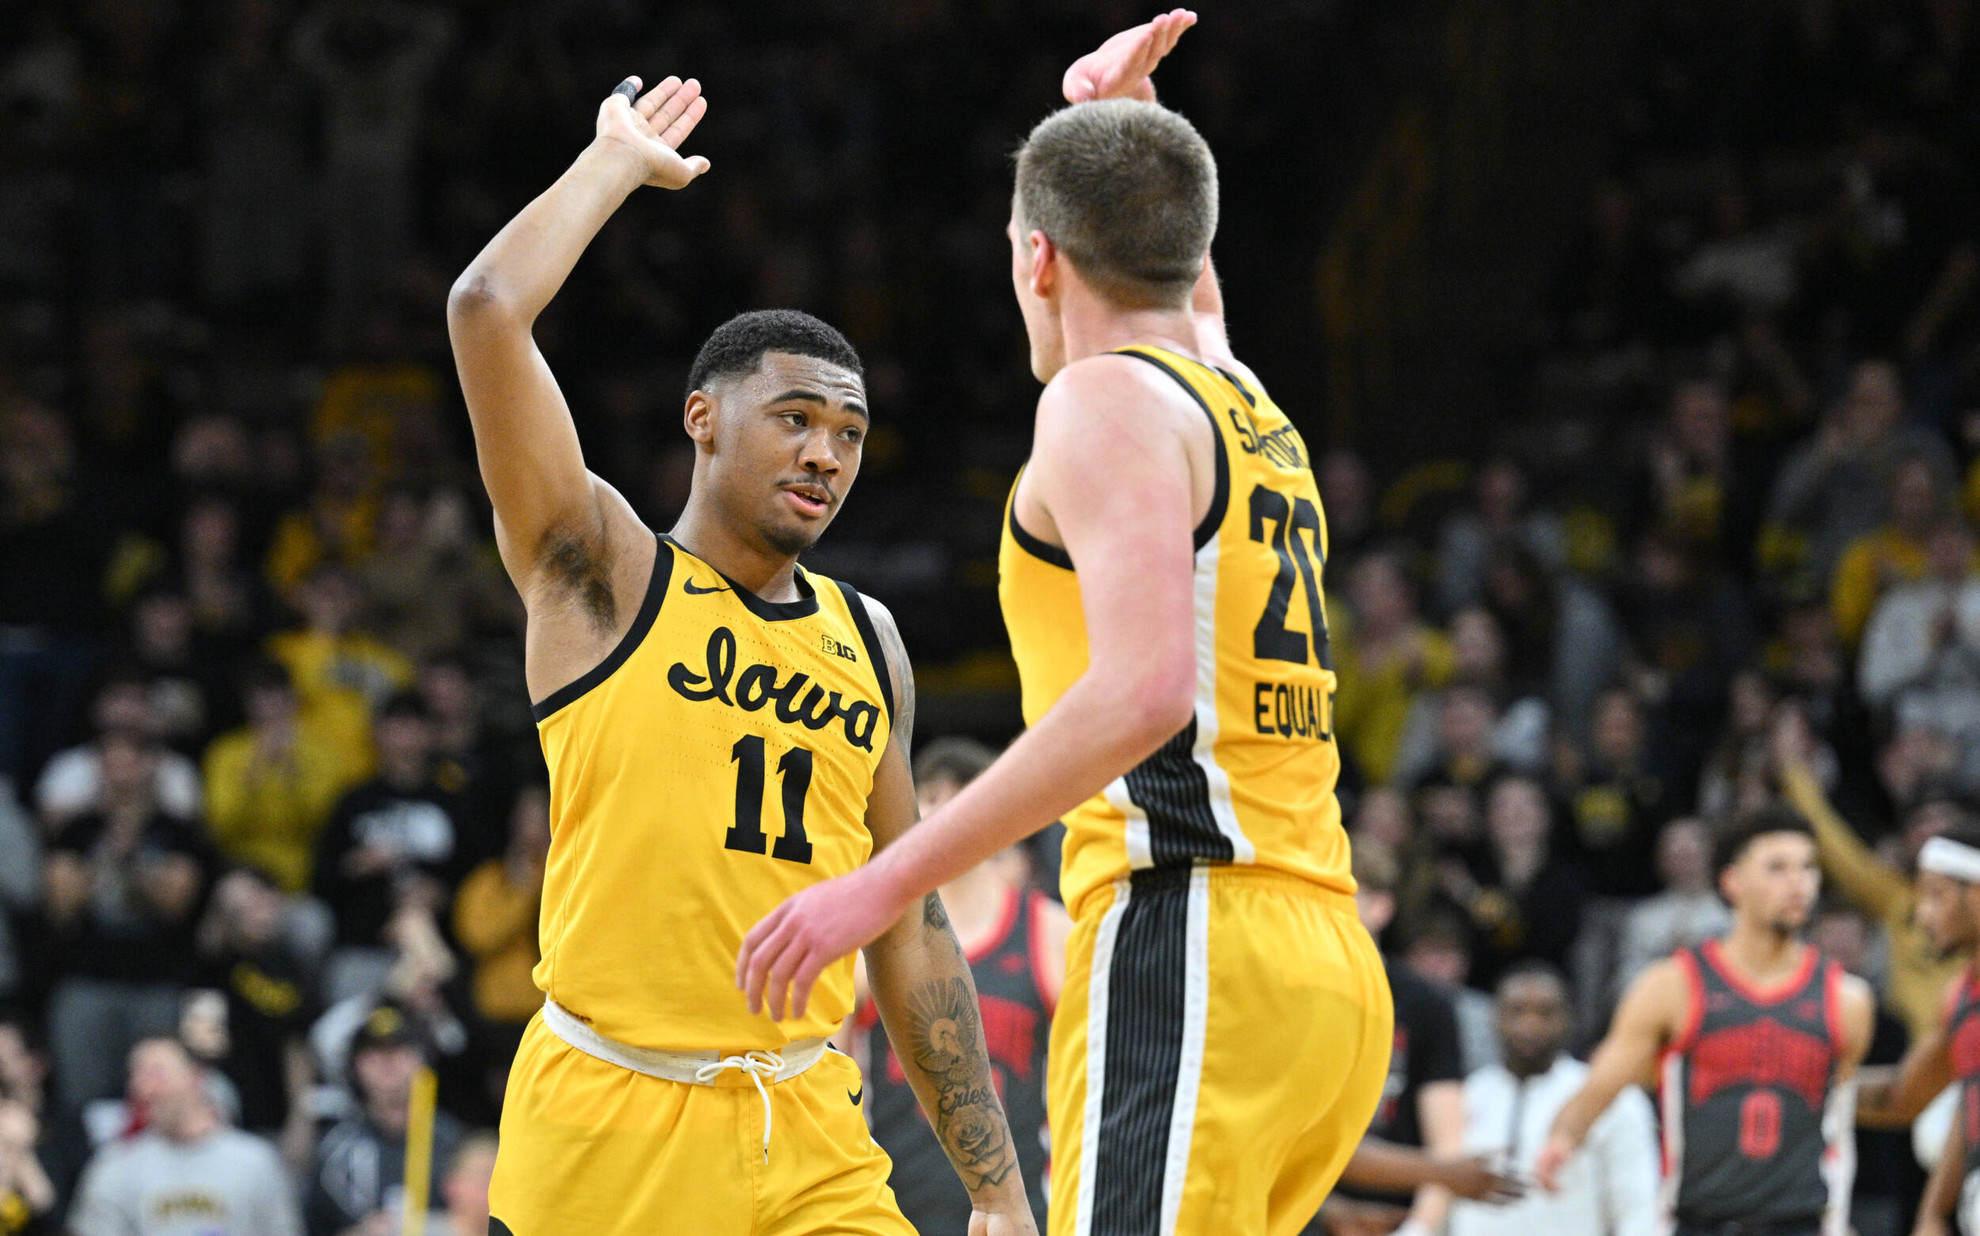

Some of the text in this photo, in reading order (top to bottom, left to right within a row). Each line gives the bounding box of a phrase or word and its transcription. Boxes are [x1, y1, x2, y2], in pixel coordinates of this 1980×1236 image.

[1249, 483, 1335, 671] 20
[668, 627, 879, 753] Iowa
[1255, 682, 1335, 742] EQUAL
[725, 734, 812, 864] 11
[1740, 1088, 1781, 1159] 0
